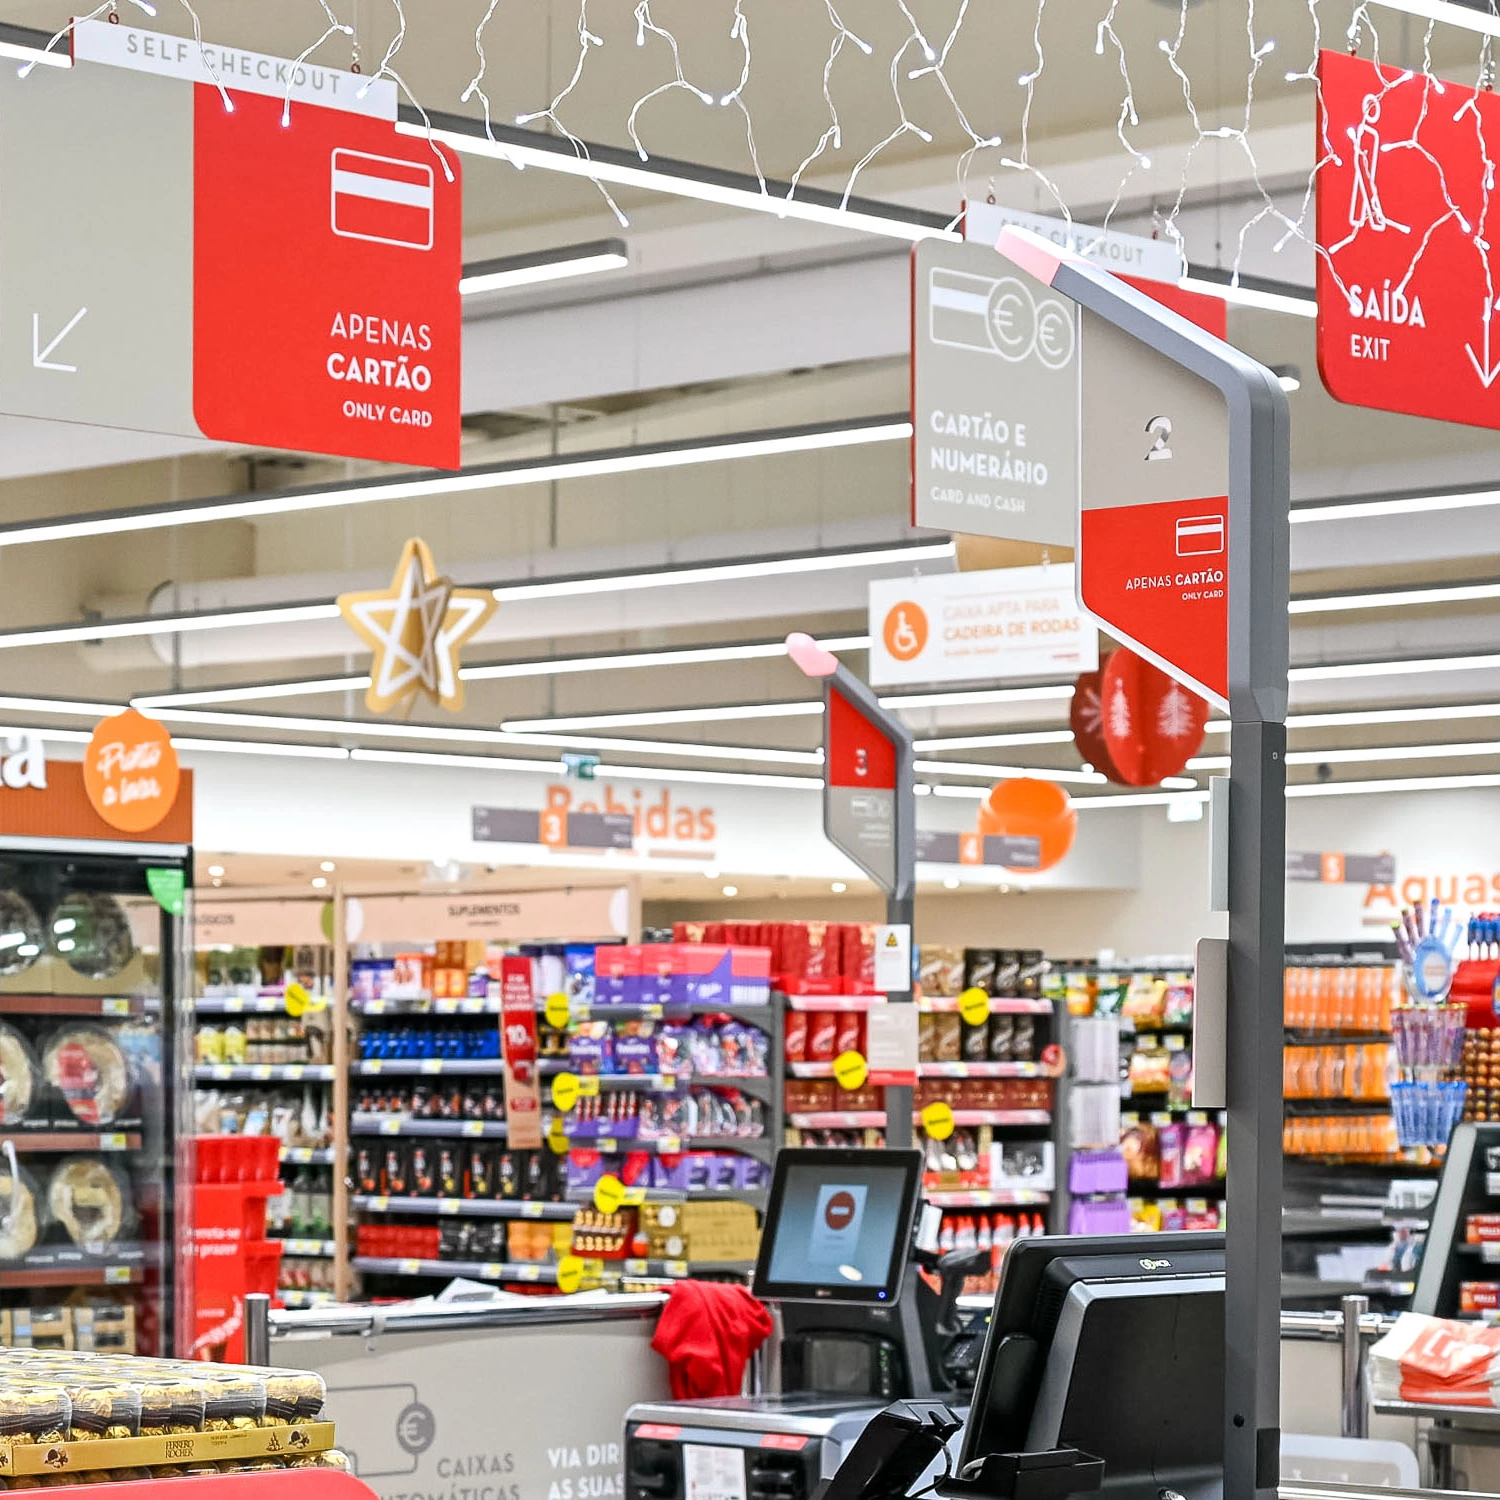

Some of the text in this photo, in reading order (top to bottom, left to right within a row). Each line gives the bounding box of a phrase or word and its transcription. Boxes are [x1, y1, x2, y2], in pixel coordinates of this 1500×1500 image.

[127, 33, 342, 94] SELF CHECKOUT
[1349, 280, 1426, 328] SAÍDA
[330, 312, 432, 351] APENAS
[1350, 334, 1391, 361] EXIT
[326, 353, 432, 393] CARTÃO
[342, 400, 433, 428] ONLY CARD
[930, 410, 1027, 447] CARTÃO E
[1144, 415, 1174, 461] 2
[930, 448, 1048, 486] NUMERÁRIO
[930, 486, 1026, 512] CARD AND CASH
[1125, 569, 1224, 590] APENAS CARTÃO
[1181, 588, 1224, 601] ONLY CARD
[943, 617, 1081, 641] CADEIRA DE RODAS
[545, 815, 561, 843] 3
[437, 1453, 515, 1479] CAIXAS
[547, 1446, 620, 1469] VIA DIR
[547, 1479, 572, 1500] AS
